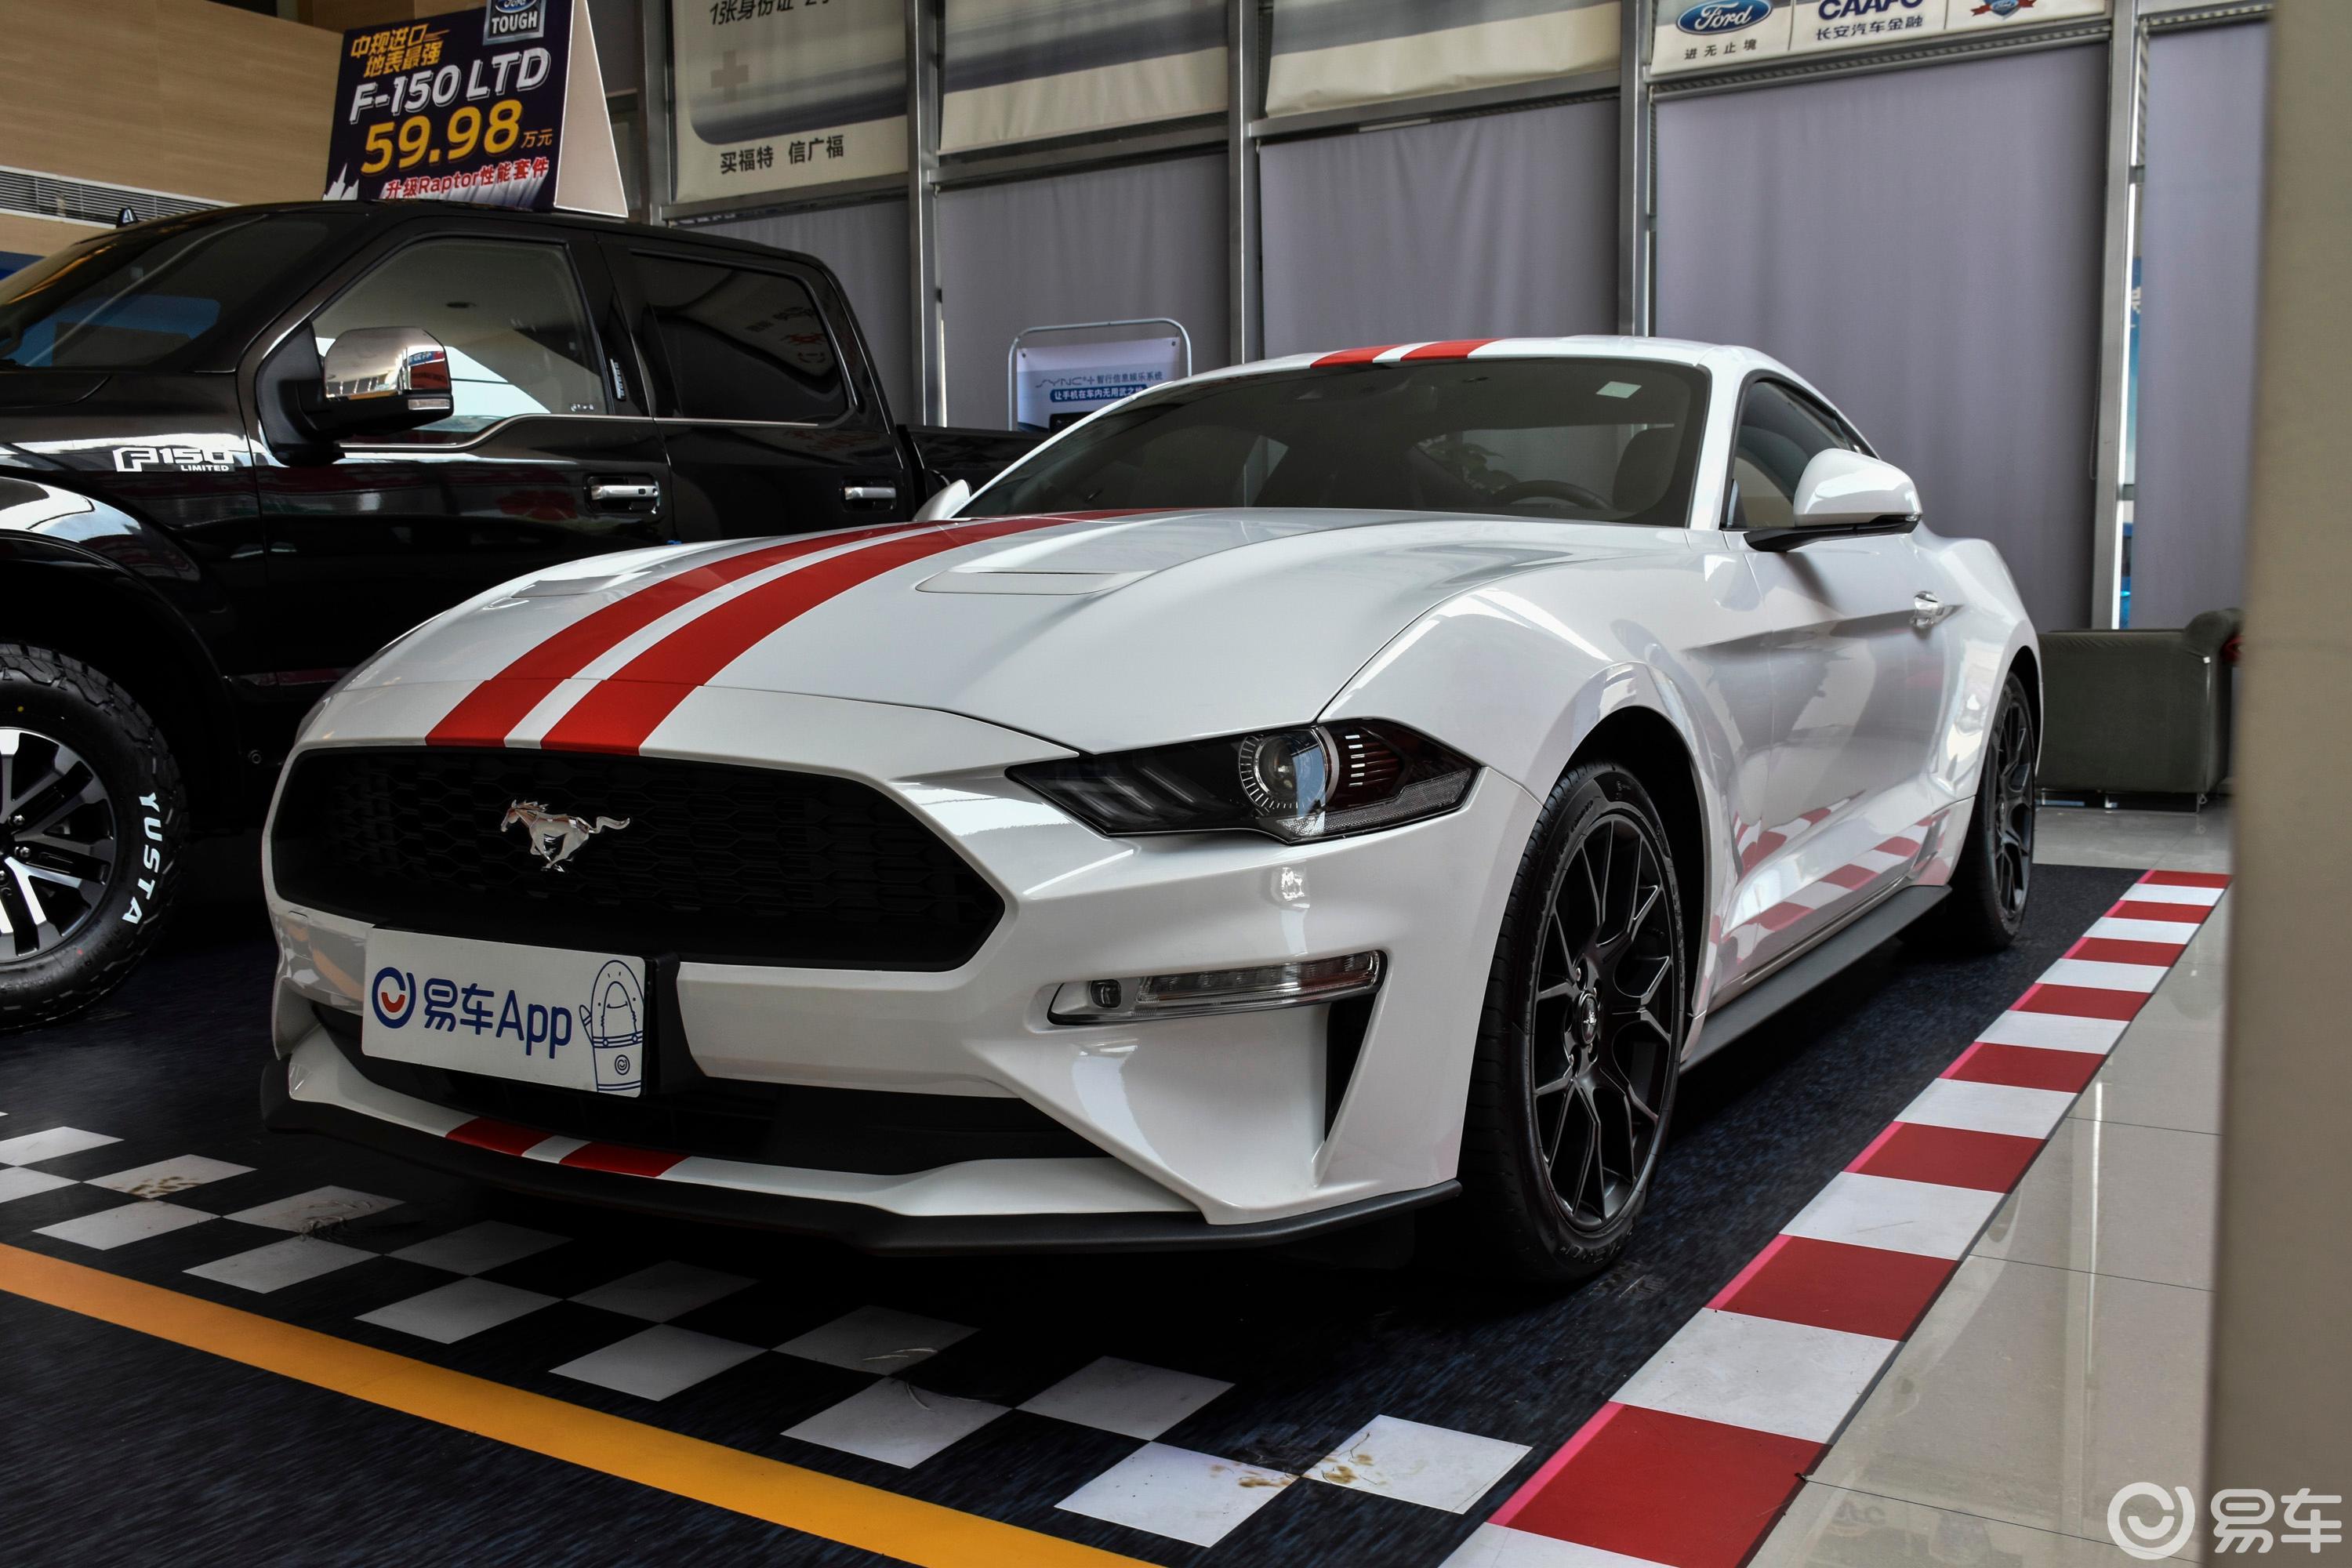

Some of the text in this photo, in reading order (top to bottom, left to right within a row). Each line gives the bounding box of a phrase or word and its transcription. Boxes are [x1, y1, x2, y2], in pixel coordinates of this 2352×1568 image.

[492, 11, 538, 34] TOUGH
[1694, 2, 1754, 31] Ford
[1817, 16, 1923, 40] 长安汽车金融
[350, 24, 430, 58] 中规进口
[364, 40, 444, 78] 地表最强
[1684, 39, 1758, 60] 进无止境
[349, 47, 551, 124] F-150 LTD
[361, 99, 553, 176] 59.98 万元
[720, 135, 844, 174] 买福特 信广福
[387, 157, 549, 199] 升级Raptor性能套件
[122, 792, 163, 925] YUSTA
[424, 978, 572, 1058] 易车App
